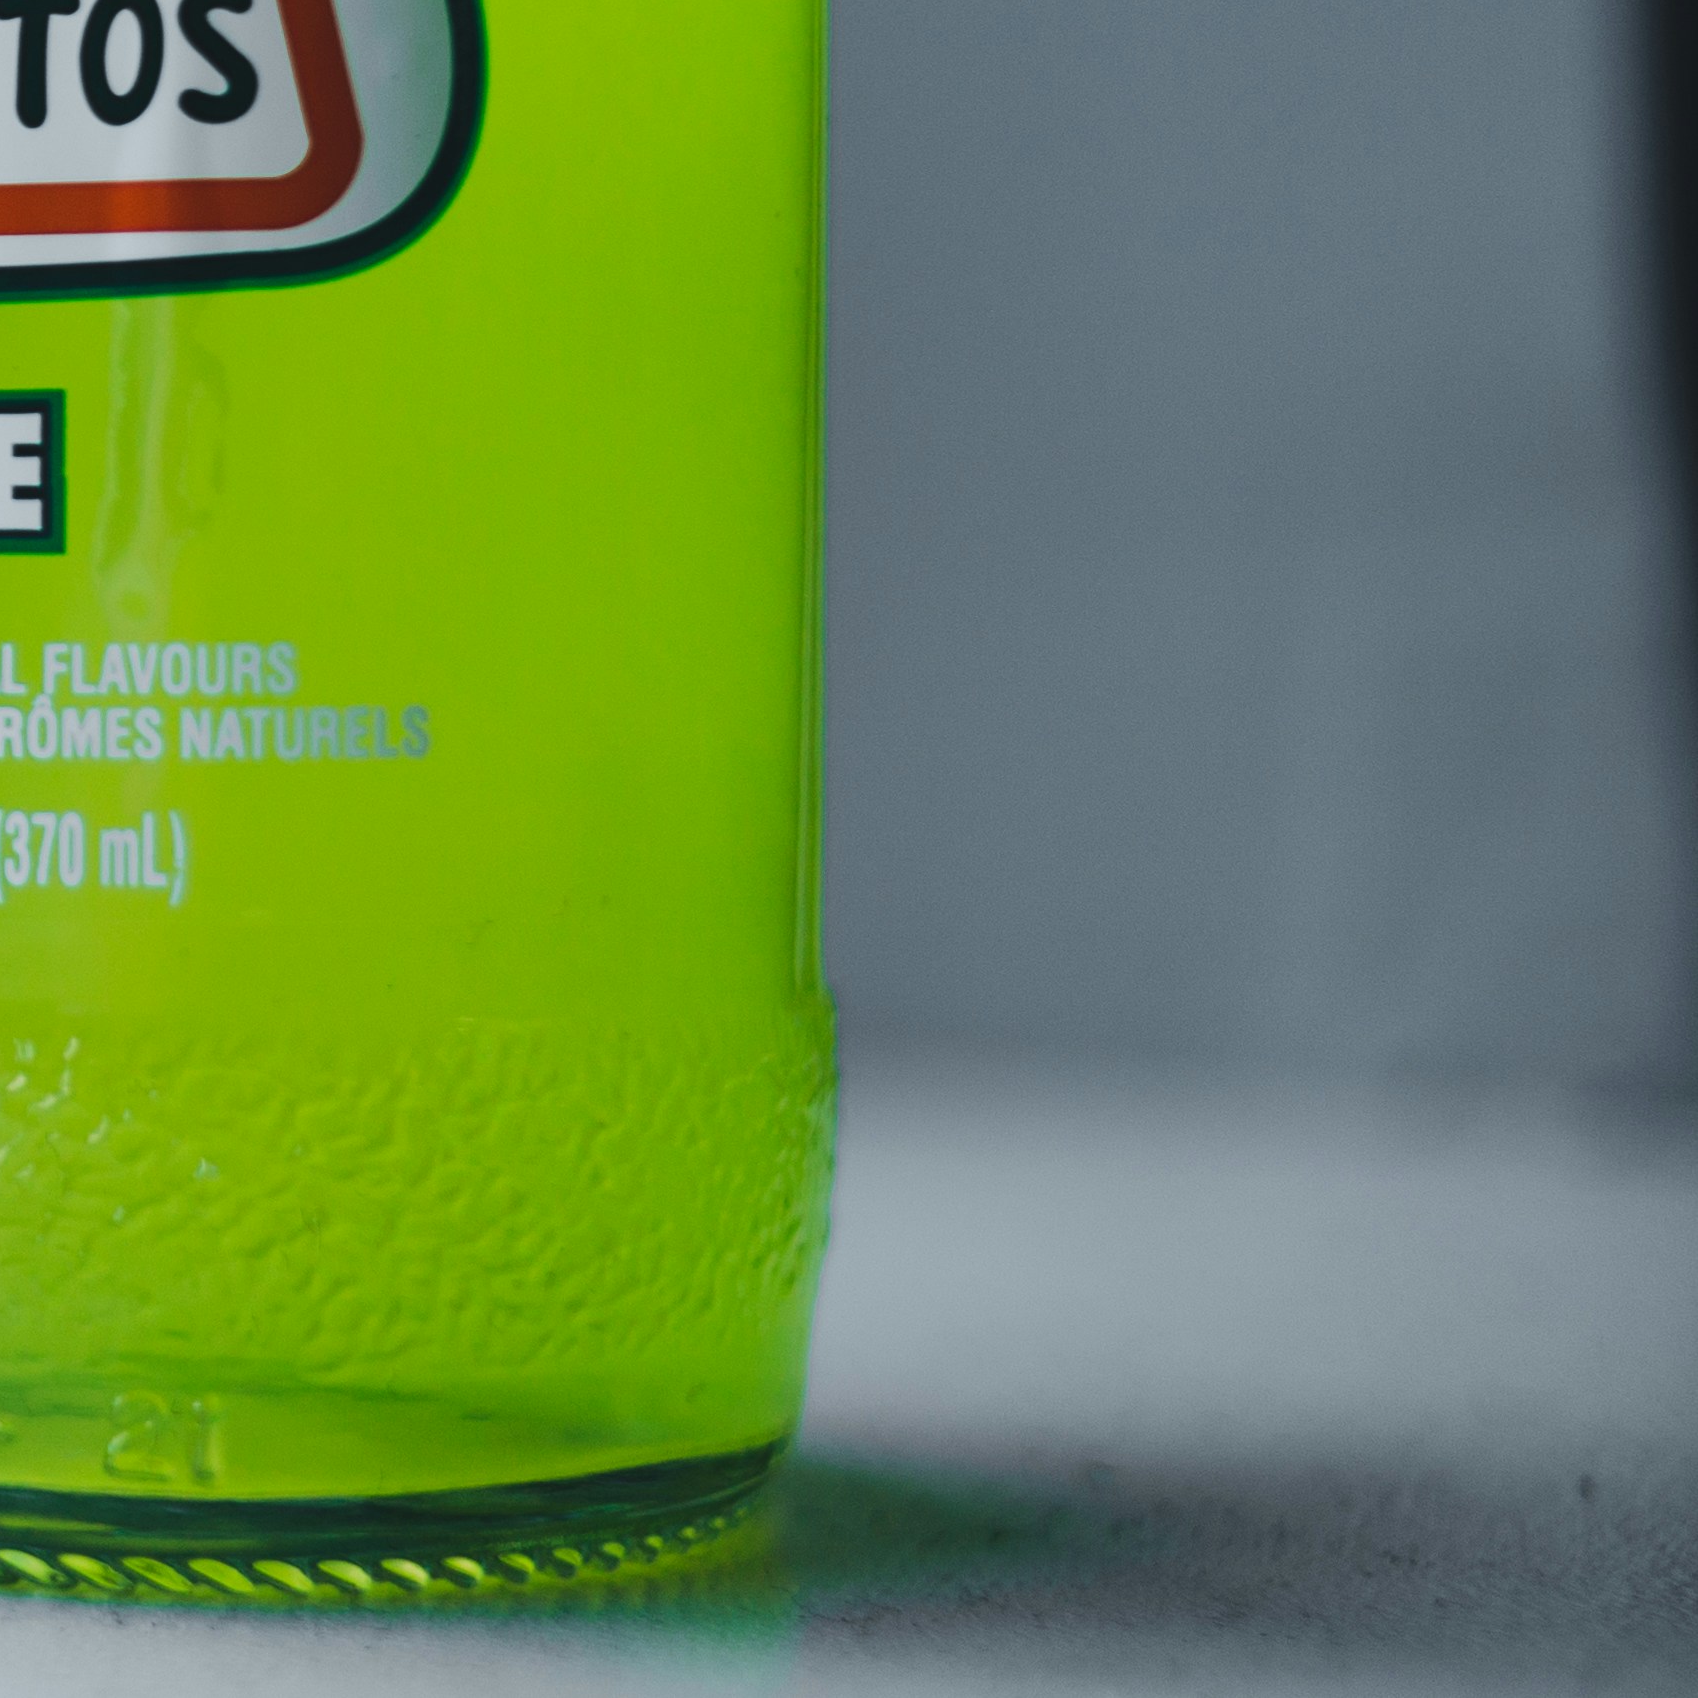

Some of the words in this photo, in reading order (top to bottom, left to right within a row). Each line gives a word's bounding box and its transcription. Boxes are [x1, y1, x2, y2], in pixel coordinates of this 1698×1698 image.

[43, 642, 298, 696] FLAVOURS
[180, 705, 431, 761] NATURELS
[100, 809, 188, 907] mL)
